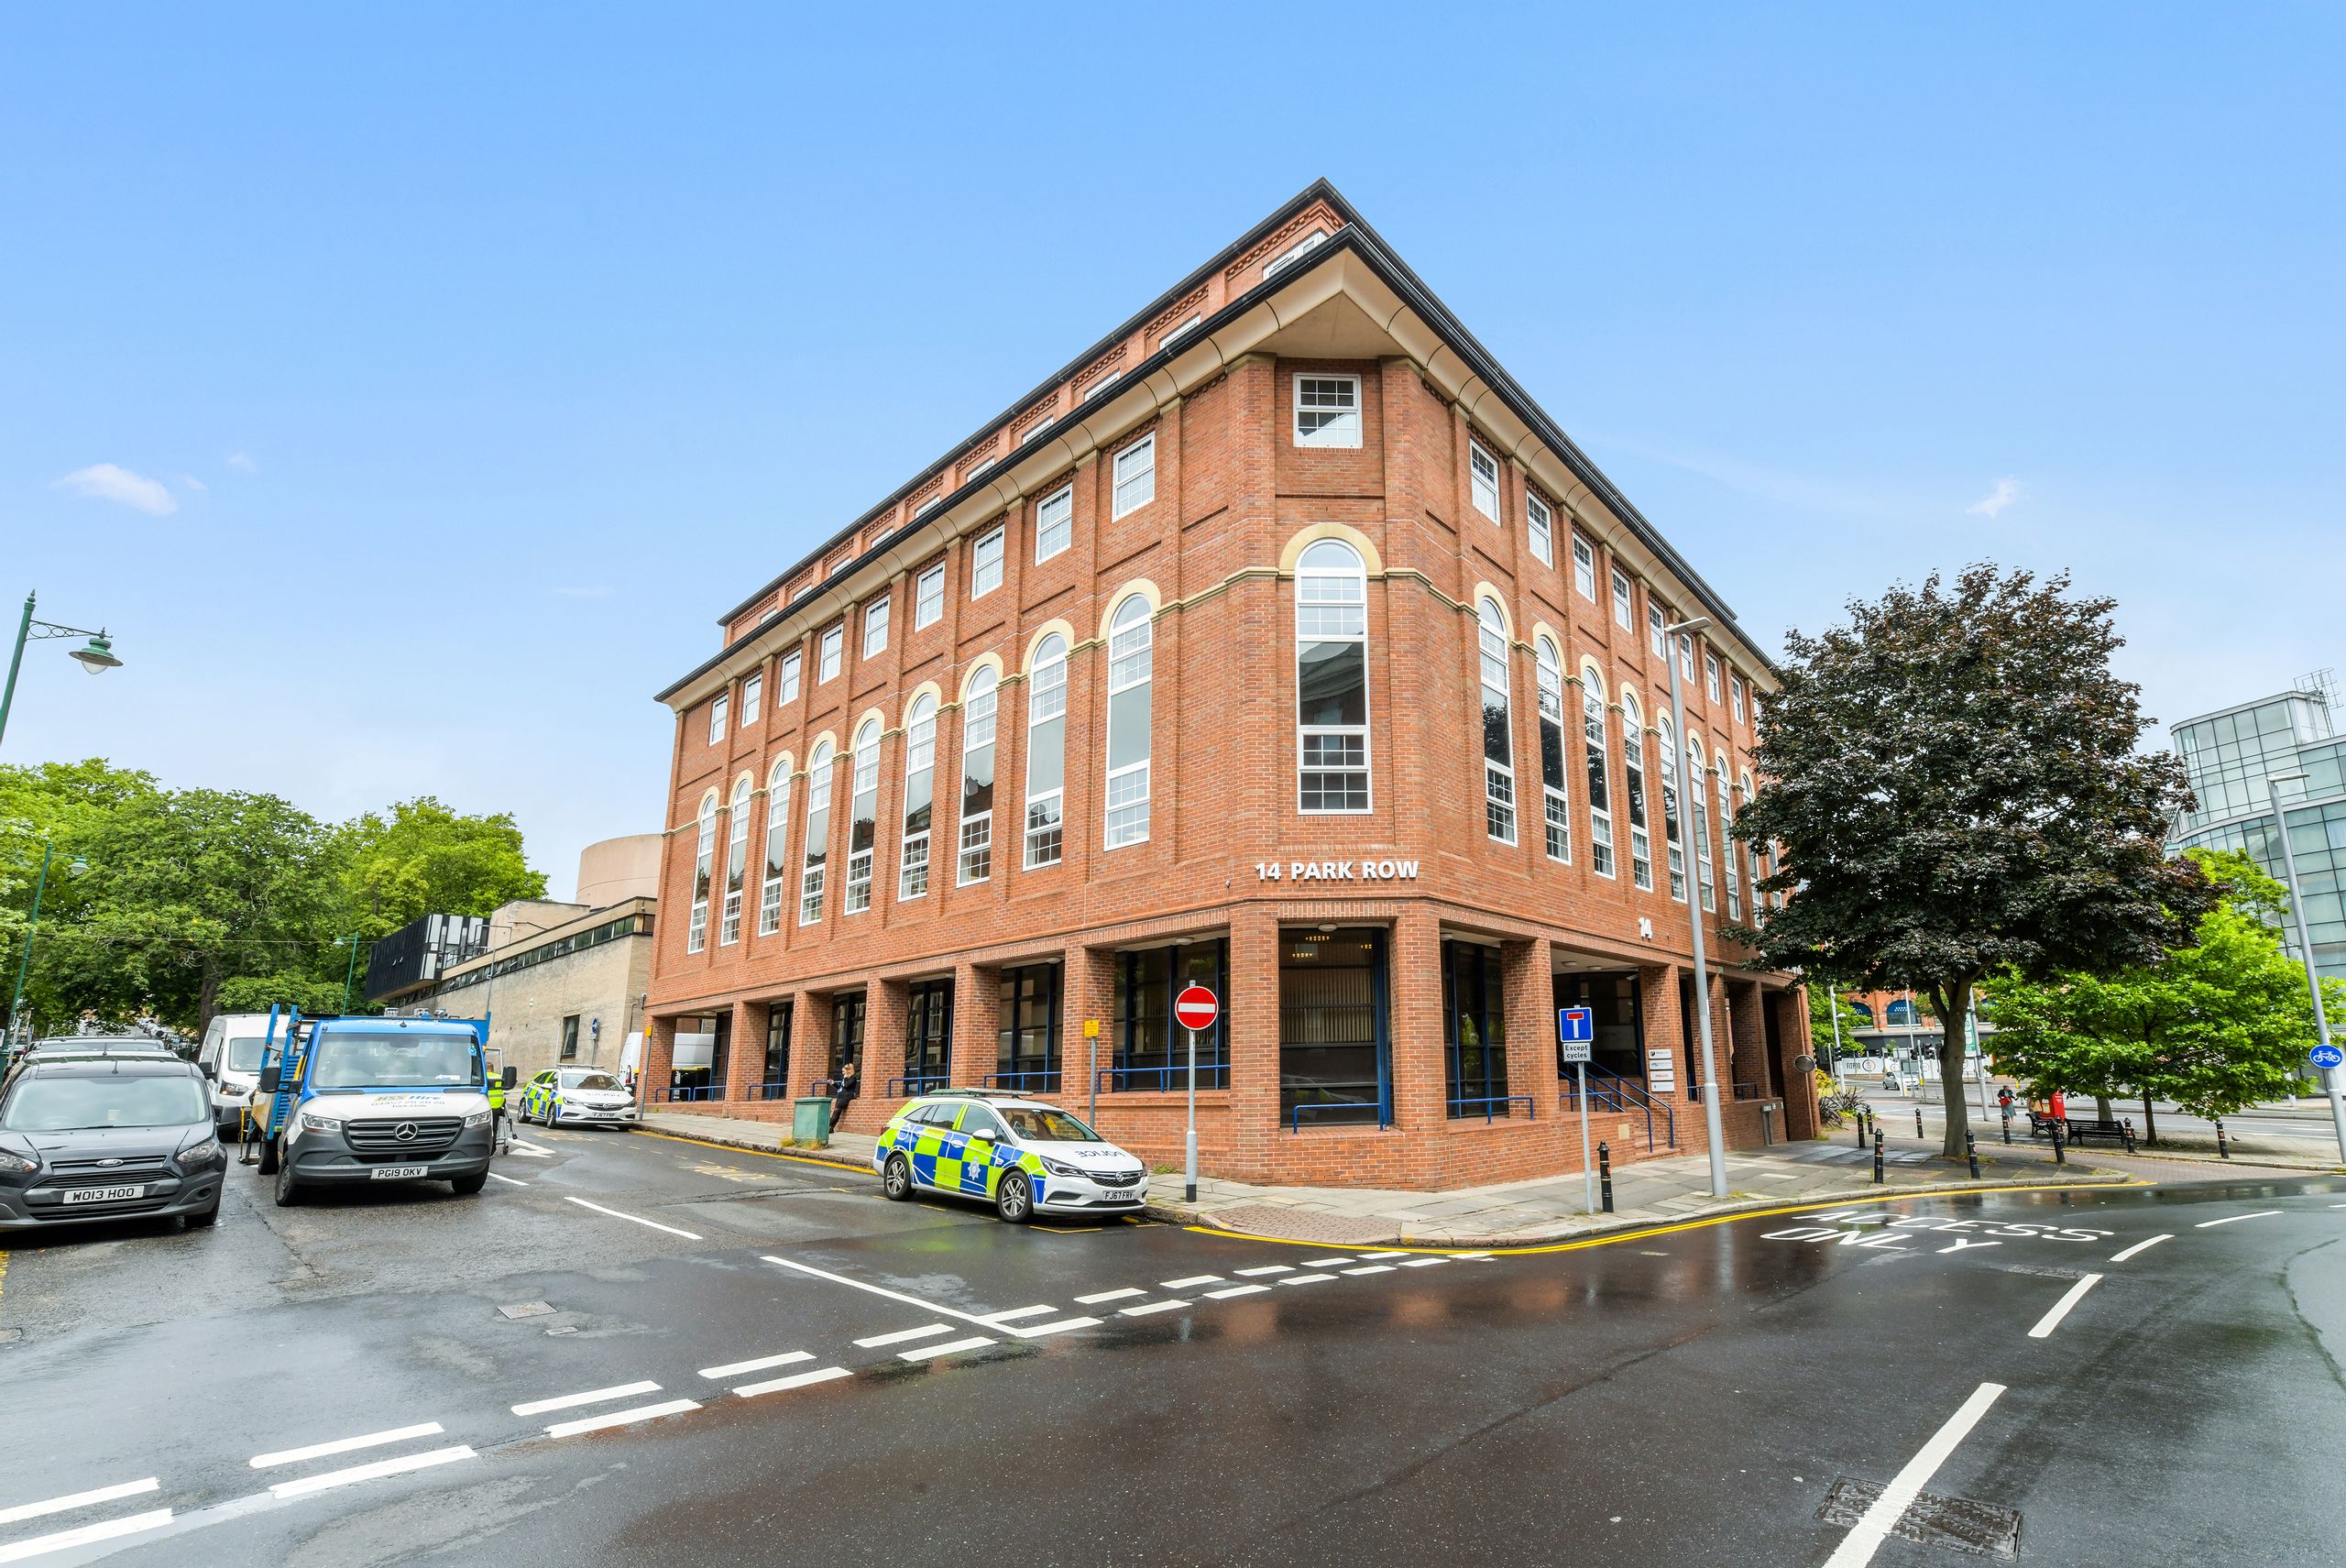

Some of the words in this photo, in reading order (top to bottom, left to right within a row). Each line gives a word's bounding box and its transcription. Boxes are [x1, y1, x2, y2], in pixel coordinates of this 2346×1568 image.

[1255, 862, 1282, 881] 14
[1290, 861, 1354, 881] PARK
[1362, 861, 1420, 880] ROW
[1638, 916, 1653, 939] 14
[378, 1168, 400, 1178] PG19
[72, 1190, 104, 1201] WO13
[1792, 1211, 2115, 1242] ACCESS
[1760, 1227, 2003, 1254] ONLY
